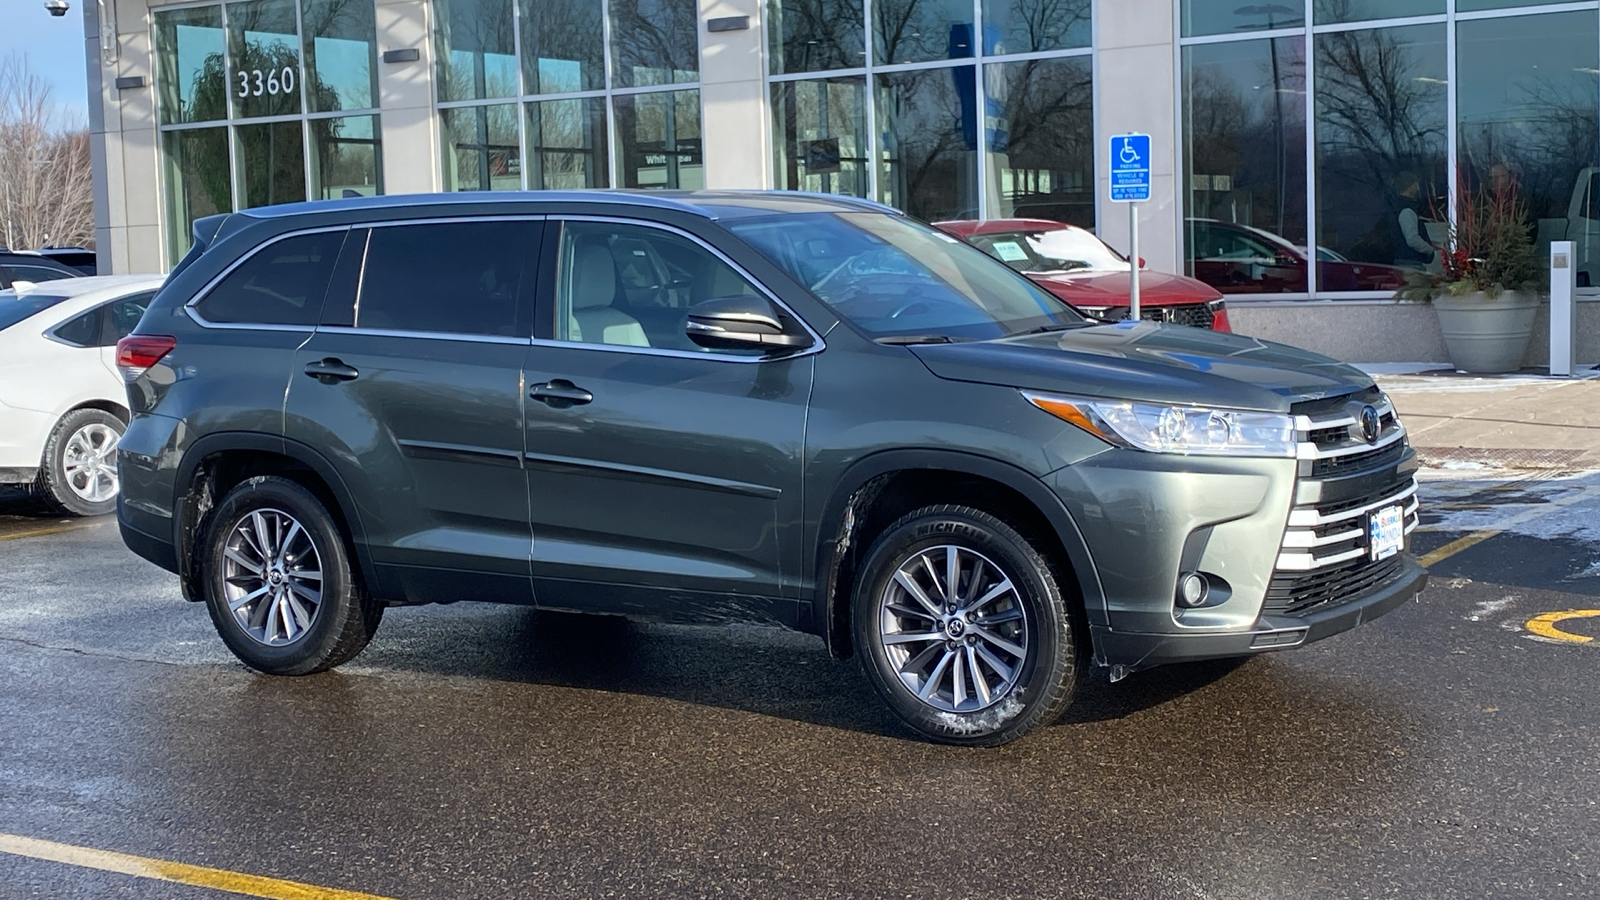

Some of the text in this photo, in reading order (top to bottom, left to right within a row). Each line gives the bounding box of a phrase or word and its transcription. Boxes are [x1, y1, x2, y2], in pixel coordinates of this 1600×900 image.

[238, 66, 294, 98] 3360
[916, 522, 989, 541] MICHELIN
[1381, 526, 1402, 545] HONDA
